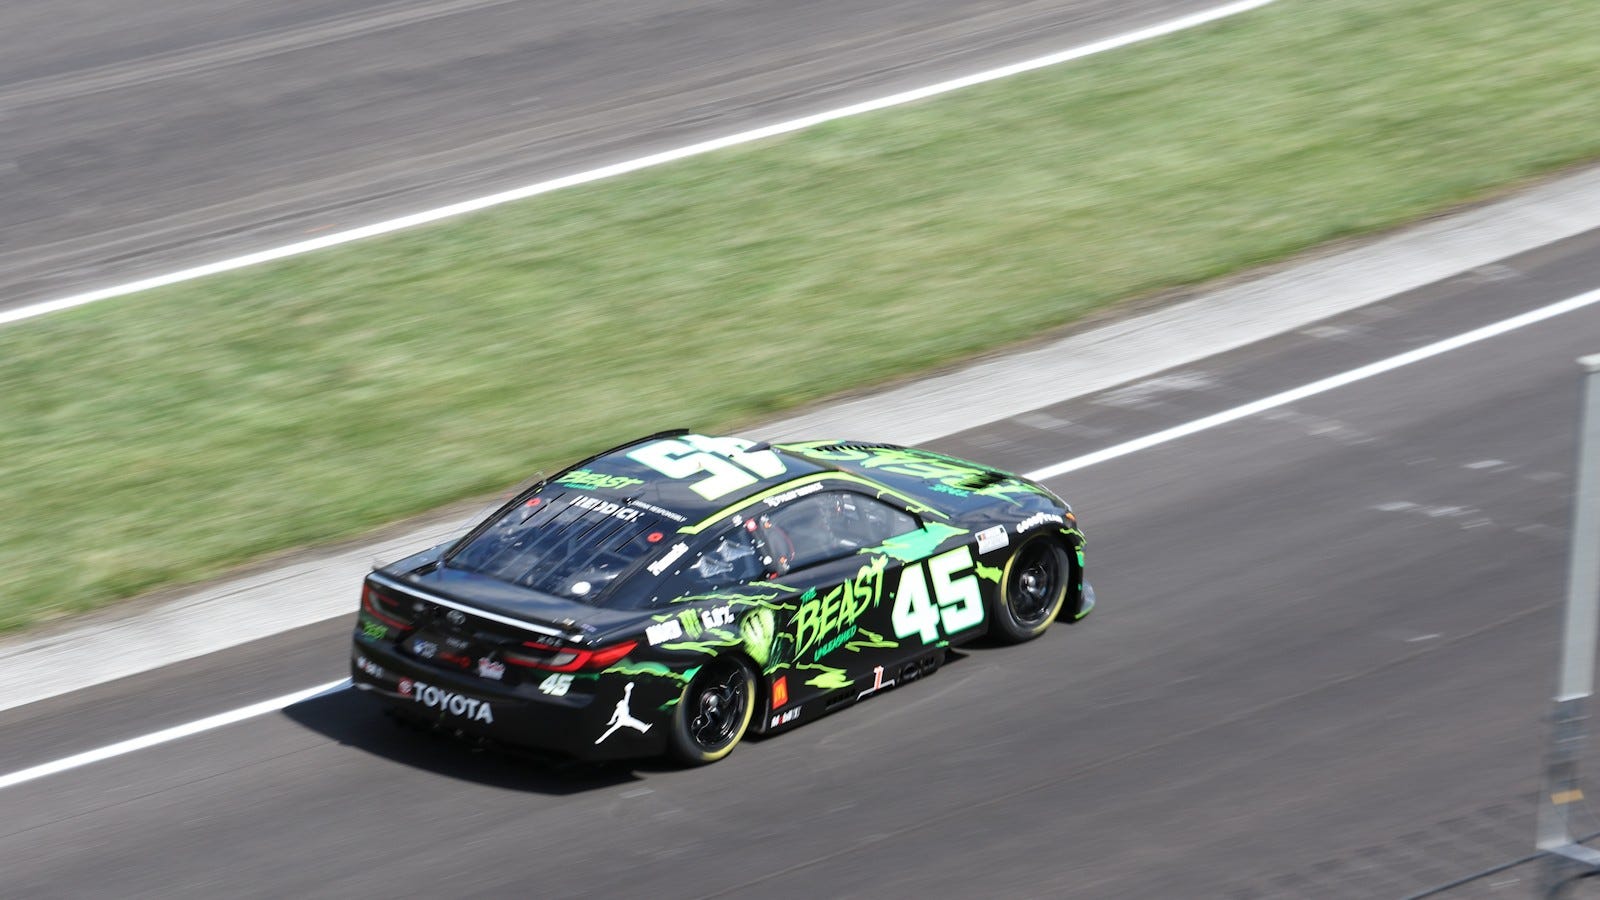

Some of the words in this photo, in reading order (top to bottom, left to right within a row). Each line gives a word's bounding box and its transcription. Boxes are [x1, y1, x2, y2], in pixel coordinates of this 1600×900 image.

[626, 434, 787, 501] 45
[787, 554, 889, 663] BEAST
[892, 545, 985, 645] 45
[413, 681, 494, 724] TOYOTA
[538, 673, 575, 696] 45
